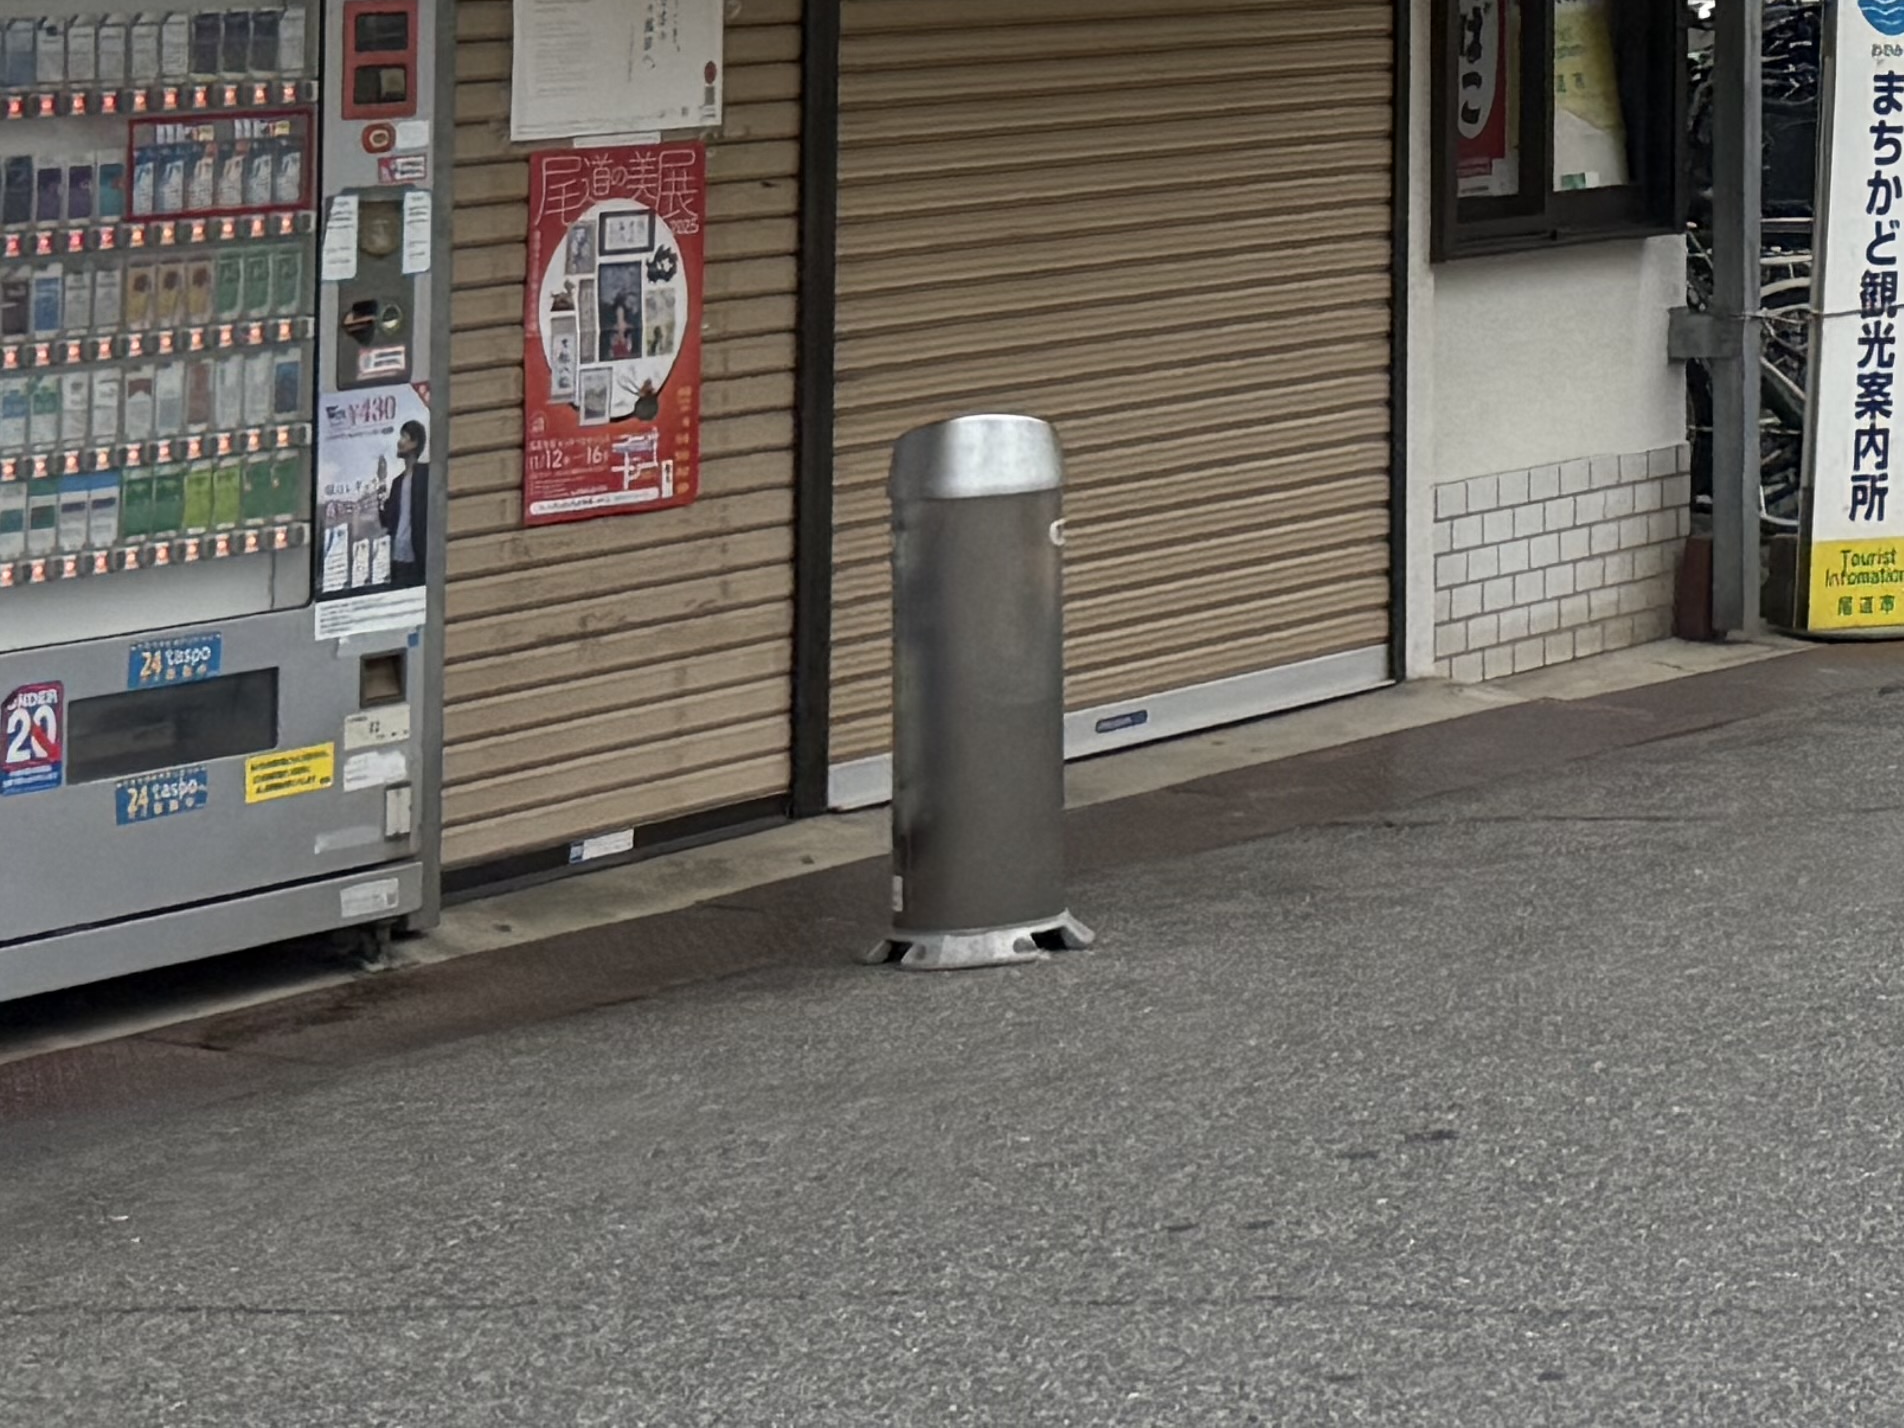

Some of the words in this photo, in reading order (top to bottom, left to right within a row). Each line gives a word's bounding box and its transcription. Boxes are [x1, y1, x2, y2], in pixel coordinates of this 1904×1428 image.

[534, 150, 700, 226] 尾道の美展
[1840, 547, 1897, 568] Tourist
[165, 646, 212, 667] taspo
[152, 776, 199, 799] taspo
